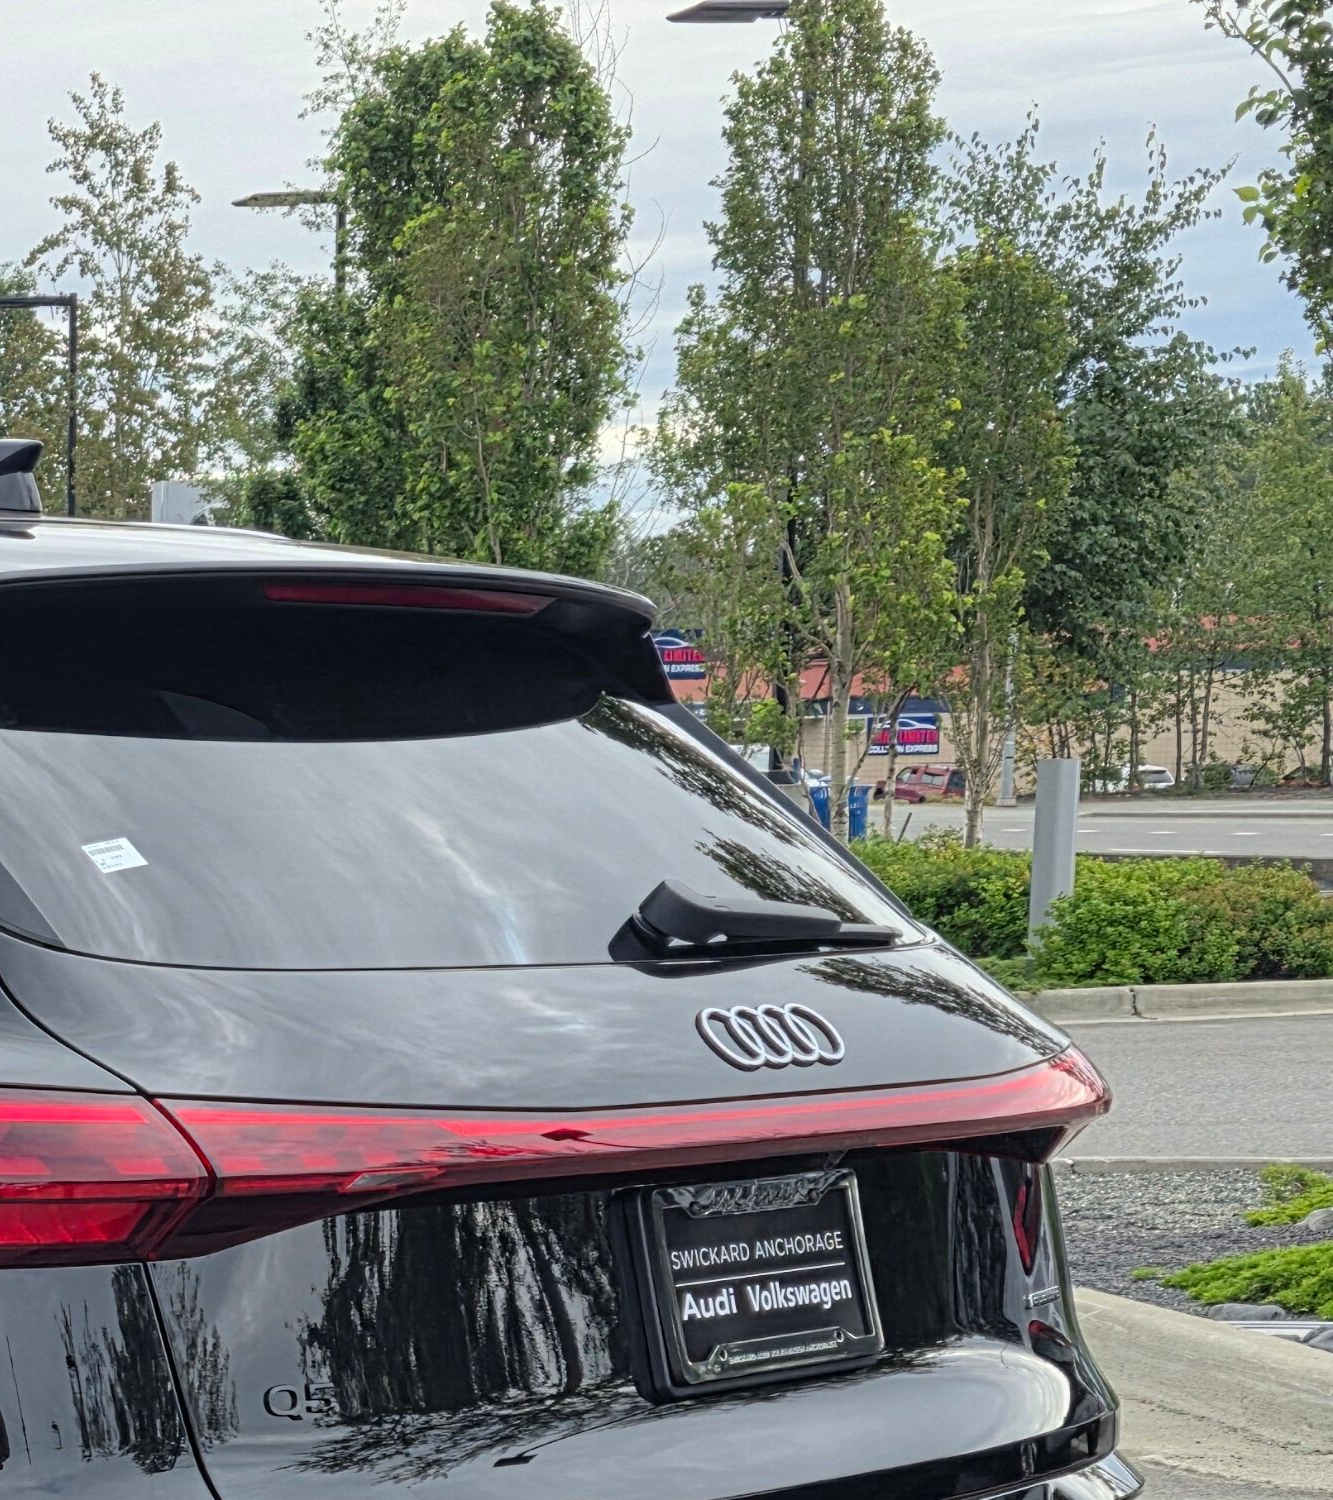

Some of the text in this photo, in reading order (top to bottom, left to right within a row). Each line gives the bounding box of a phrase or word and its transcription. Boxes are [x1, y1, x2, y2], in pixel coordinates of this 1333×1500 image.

[670, 1231, 844, 1270] SWICKARD ANCHORAGE
[683, 1279, 852, 1321] Audi Volkswagen
[263, 1383, 339, 1420] Q5
